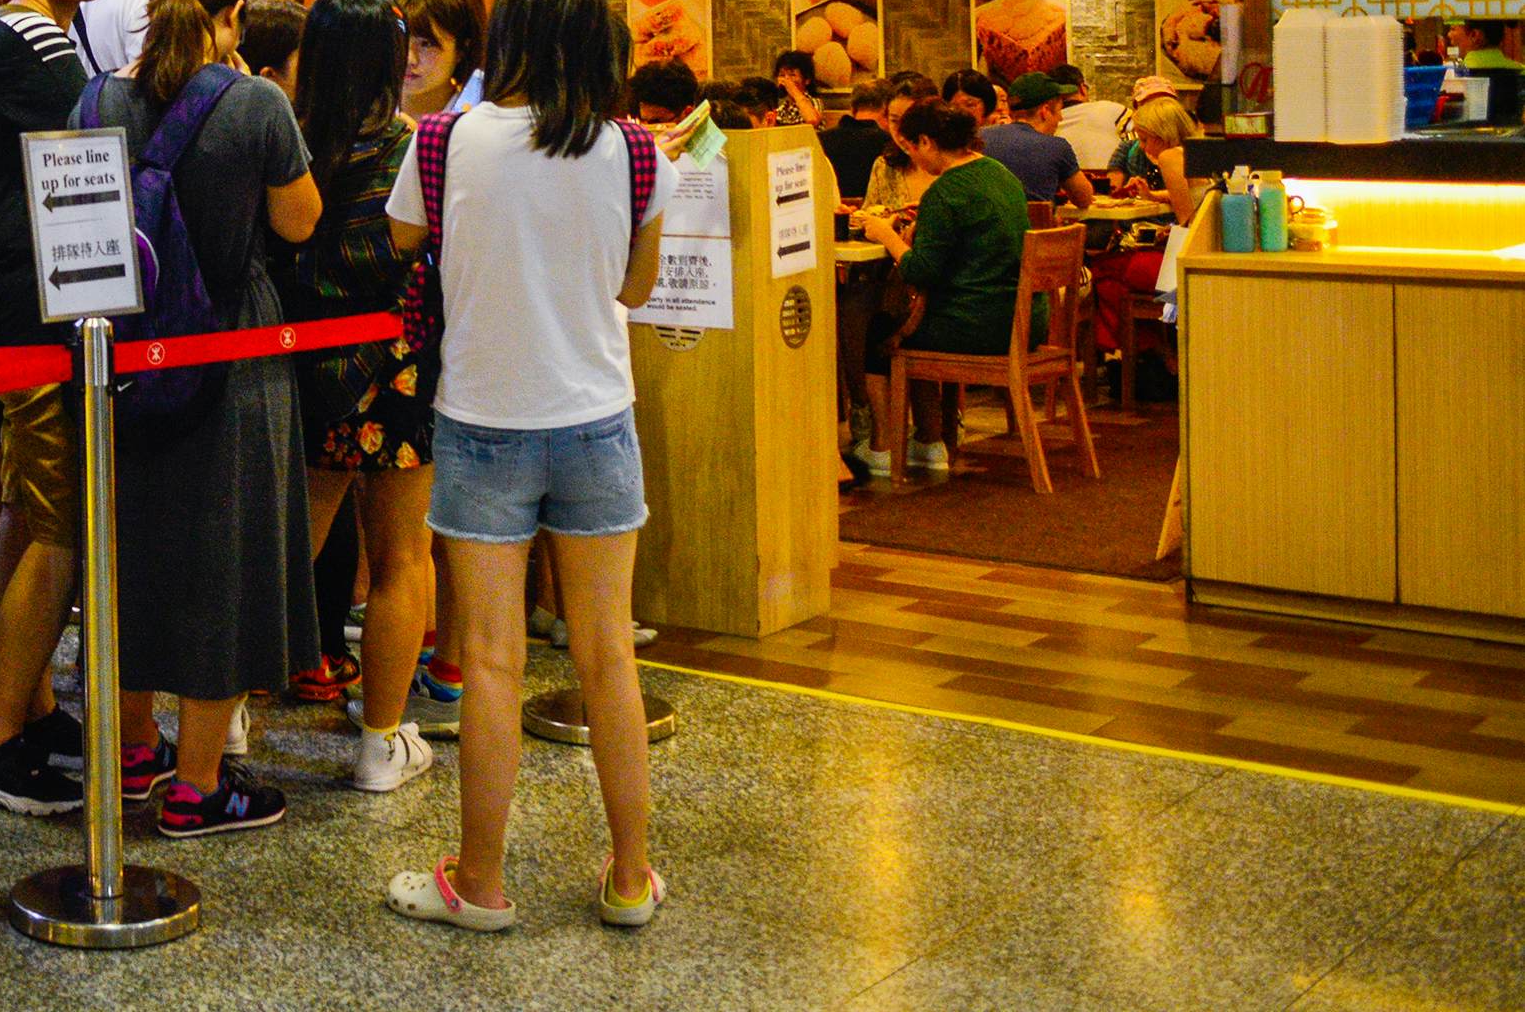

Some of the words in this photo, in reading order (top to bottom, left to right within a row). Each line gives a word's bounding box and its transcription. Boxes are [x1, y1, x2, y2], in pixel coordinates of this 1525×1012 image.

[42, 153, 82, 168] Please
[86, 150, 110, 164] line
[41, 179, 59, 193] up
[63, 174, 81, 188] for
[84, 172, 116, 187] seats
[51, 239, 121, 263] 排隊待入座
